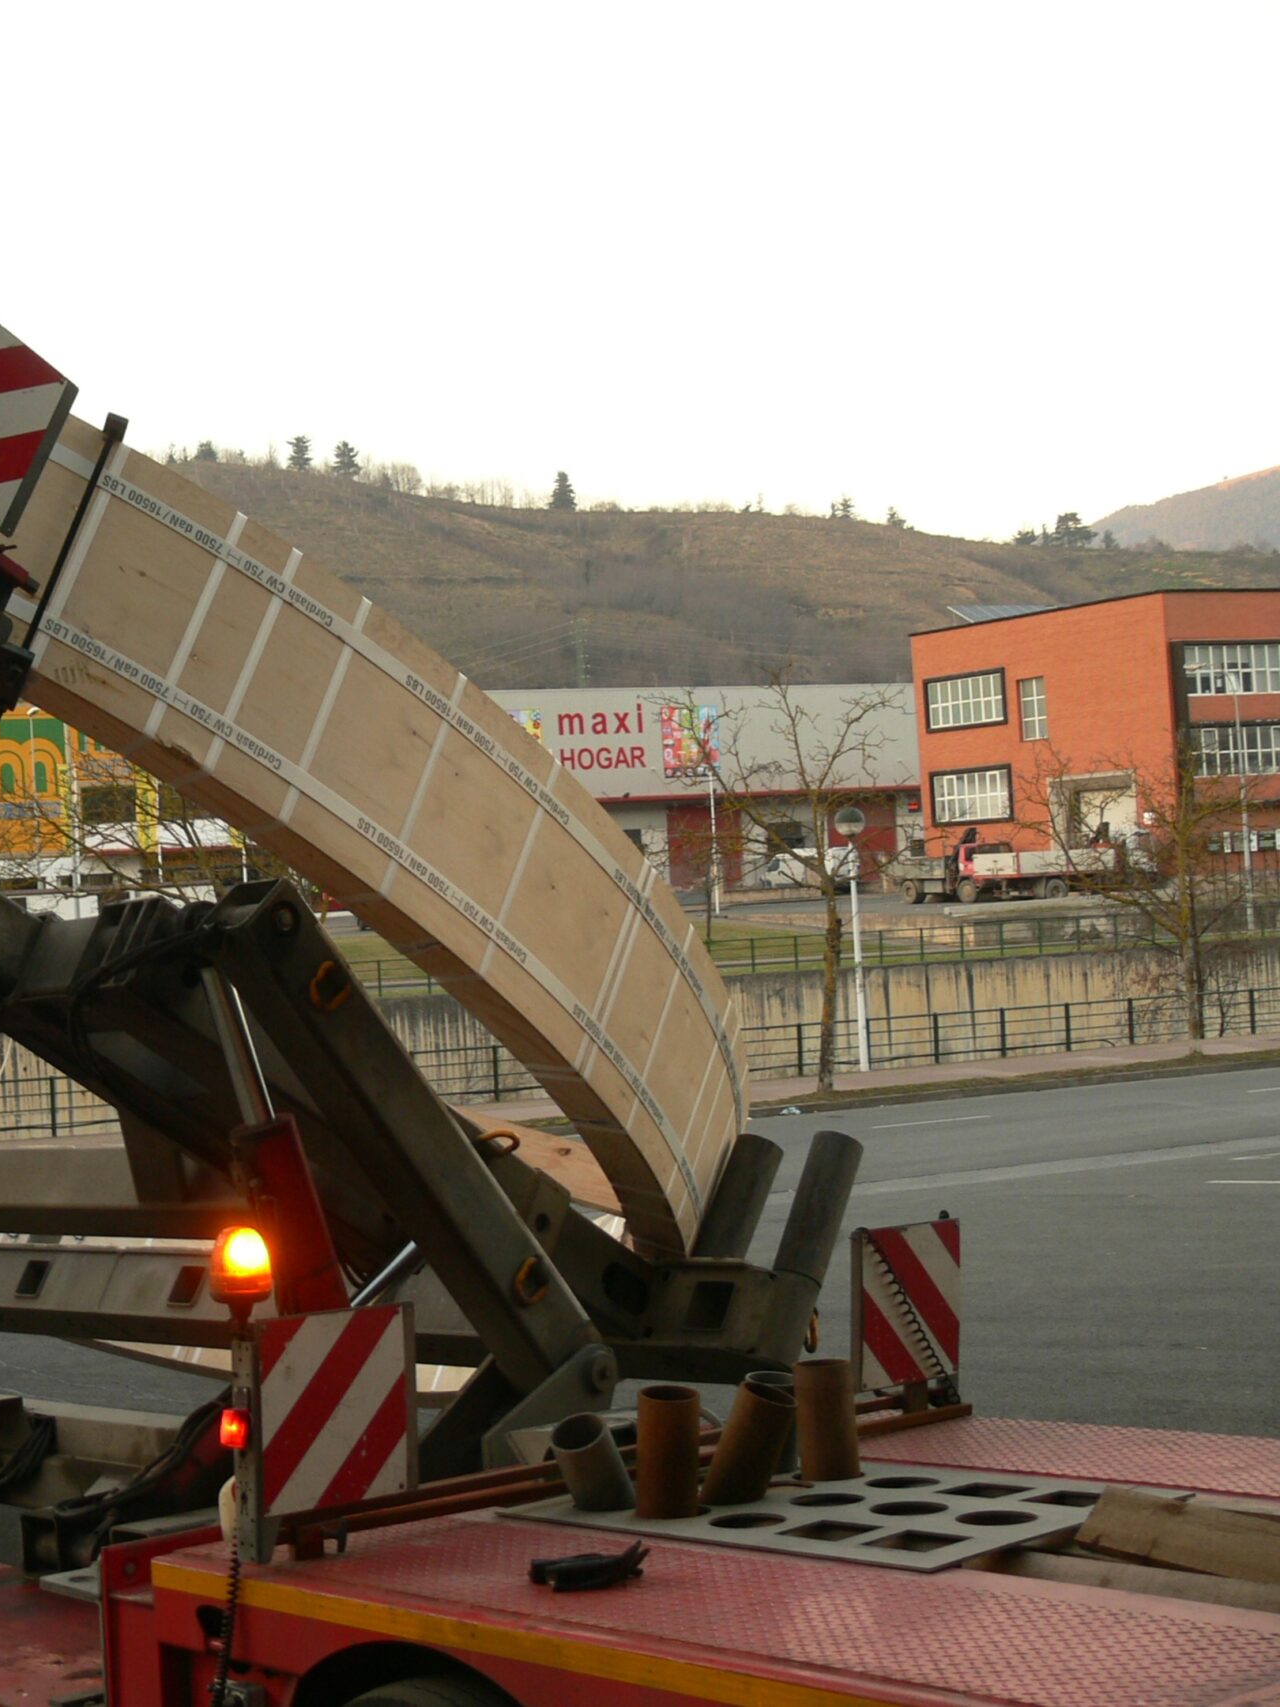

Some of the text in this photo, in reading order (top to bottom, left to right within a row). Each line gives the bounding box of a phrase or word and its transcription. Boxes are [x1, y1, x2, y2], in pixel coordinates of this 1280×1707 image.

[102, 473, 127, 496] LBS
[195, 529, 224, 554] 7500
[243, 559, 266, 582] 750
[264, 574, 286, 595] CW
[288, 588, 334, 628] Cordlash
[44, 617, 69, 638] LBS
[140, 673, 171, 699] 7500
[405, 674, 425, 695] LBS
[190, 703, 213, 725] 750
[557, 702, 645, 736] maxi
[211, 717, 234, 739] CW
[236, 732, 283, 771] Cordlash
[474, 733, 498, 757] 7500
[560, 746, 647, 771] HOGAR
[508, 761, 525, 782] 750
[523, 776, 539, 793] CW
[538, 790, 571, 826] Cordlash
[356, 816, 377, 838] LBS
[427, 872, 450, 897] 7500
[462, 901, 480, 922] 750
[479, 915, 495, 933] CW
[495, 930, 528, 964] Cordlash
